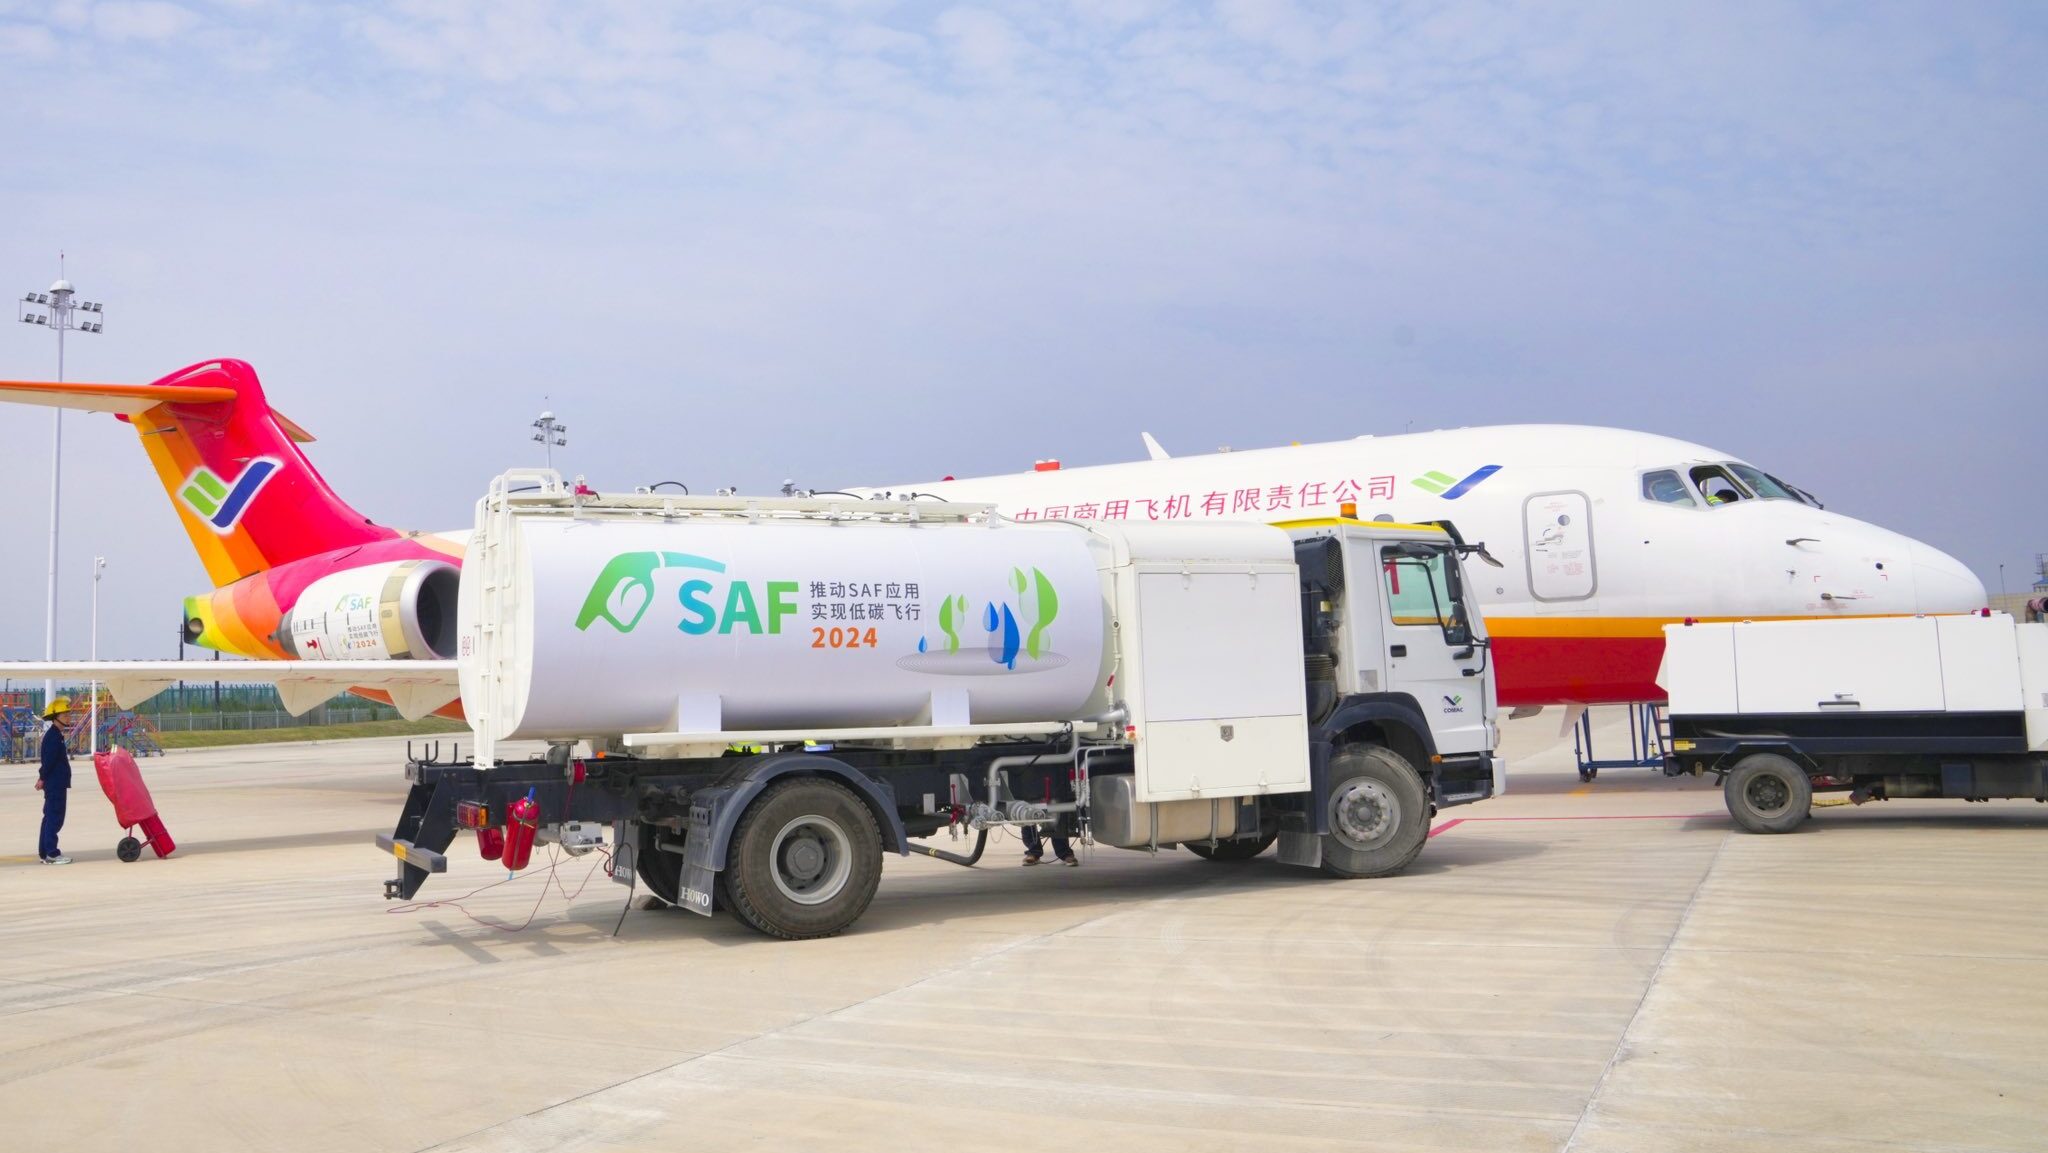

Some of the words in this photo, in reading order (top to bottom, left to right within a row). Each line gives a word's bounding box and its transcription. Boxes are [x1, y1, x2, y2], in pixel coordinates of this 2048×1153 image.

[810, 581, 920, 599] 推动SAF应用
[350, 597, 371, 610] SAF
[677, 579, 799, 635] SAF
[811, 603, 921, 621] 实现低碳飞行
[356, 639, 376, 648] 2024
[811, 627, 878, 648] 2024
[681, 886, 709, 907] HOWO
